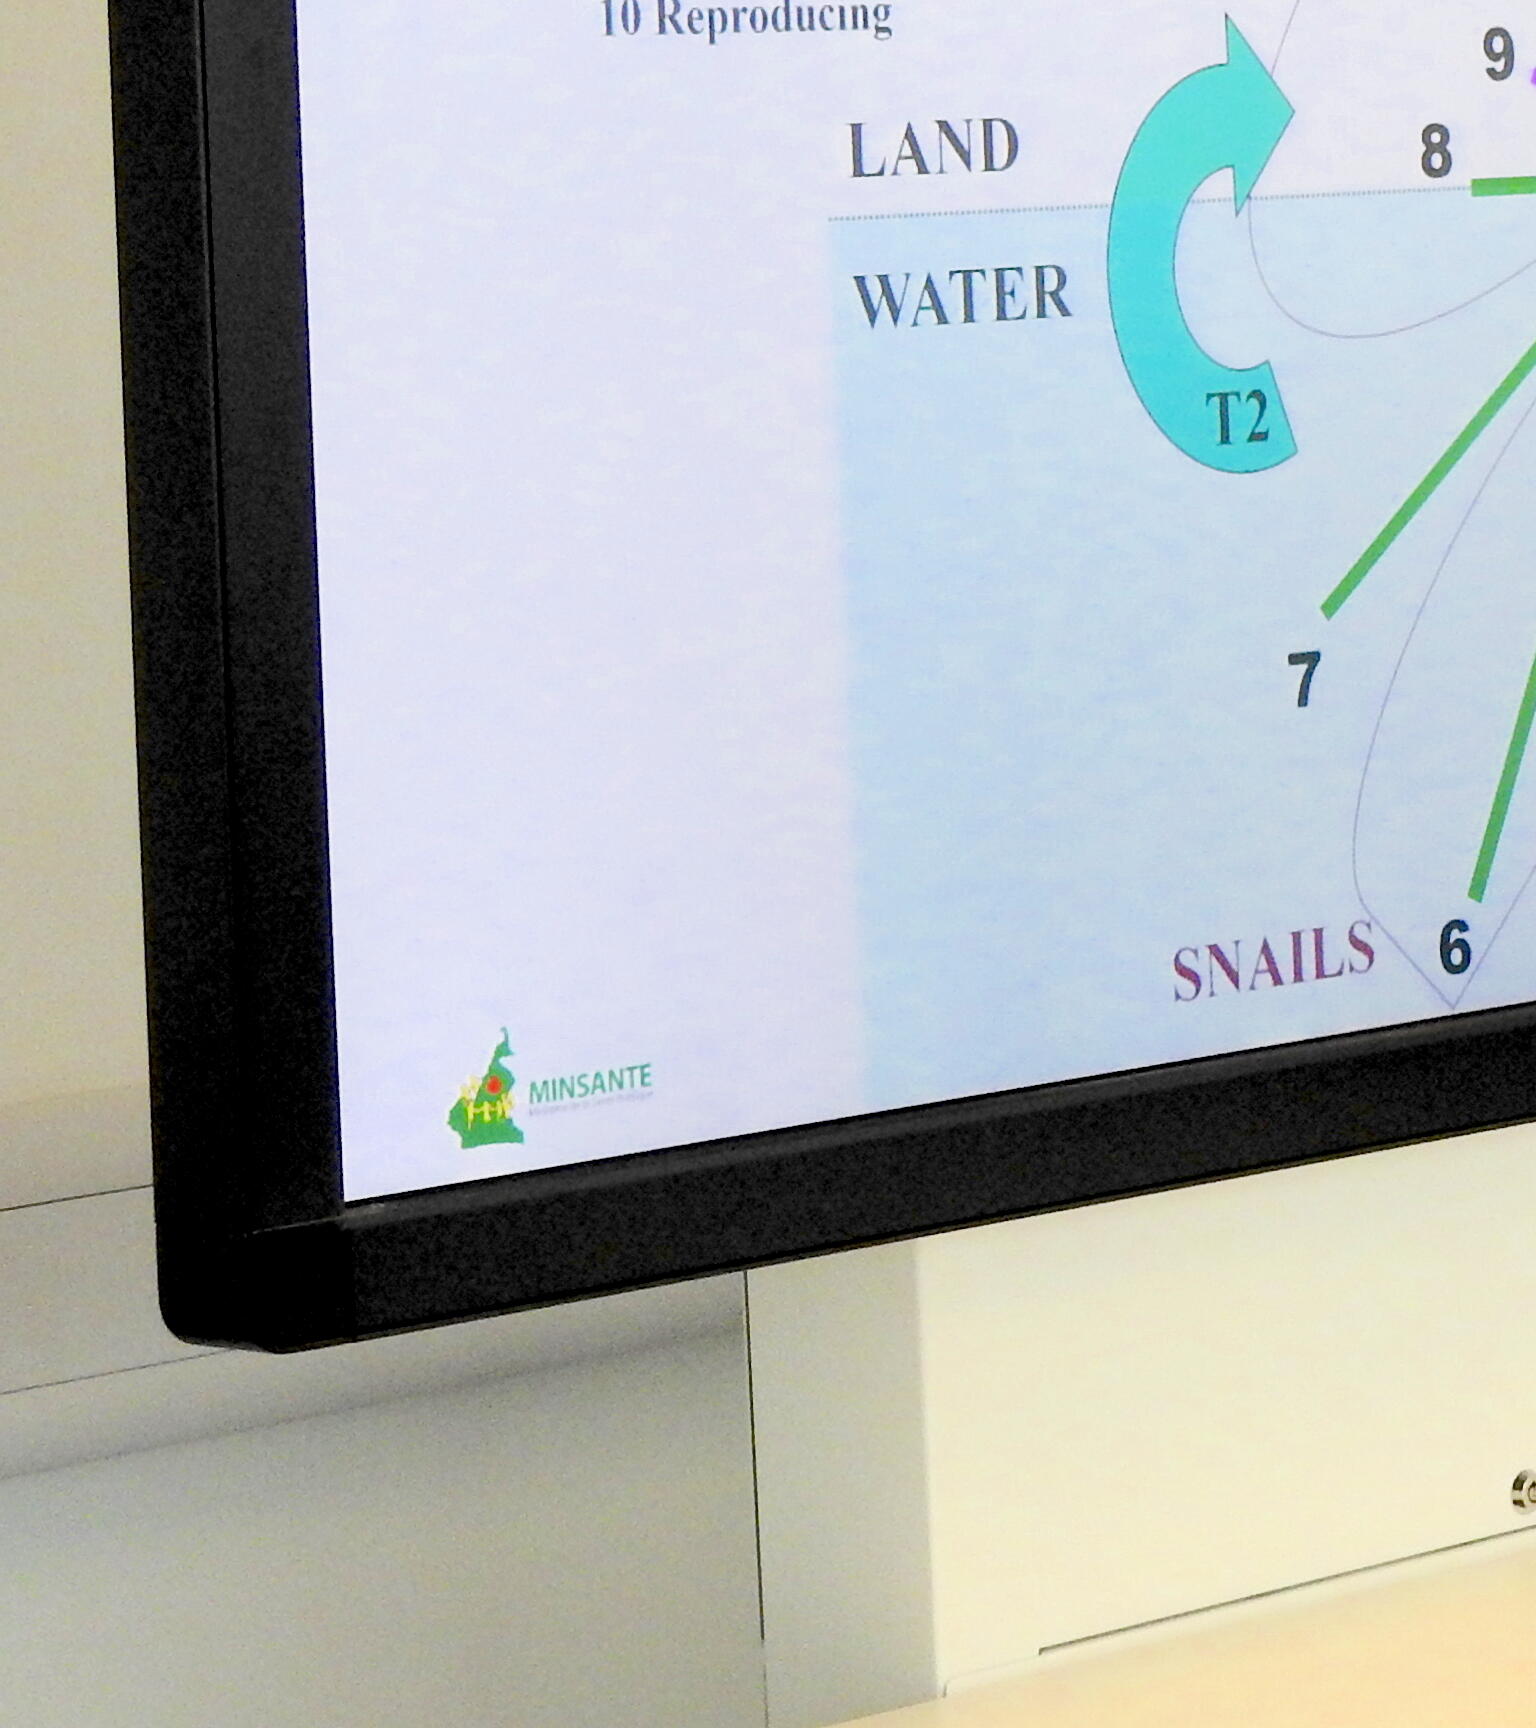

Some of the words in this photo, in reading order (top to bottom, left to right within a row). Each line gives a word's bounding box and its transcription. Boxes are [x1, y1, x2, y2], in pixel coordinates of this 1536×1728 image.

[1482, 26, 1515, 80] 9
[849, 117, 1019, 178] LAND
[1421, 123, 1452, 177] 8
[852, 264, 1072, 329] WATER
[1205, 390, 1270, 446] T2
[1288, 651, 1322, 707] 7
[1174, 920, 1375, 1003] SNAILS
[1439, 920, 1471, 974] 6
[529, 1063, 651, 1104] MINSANTE
